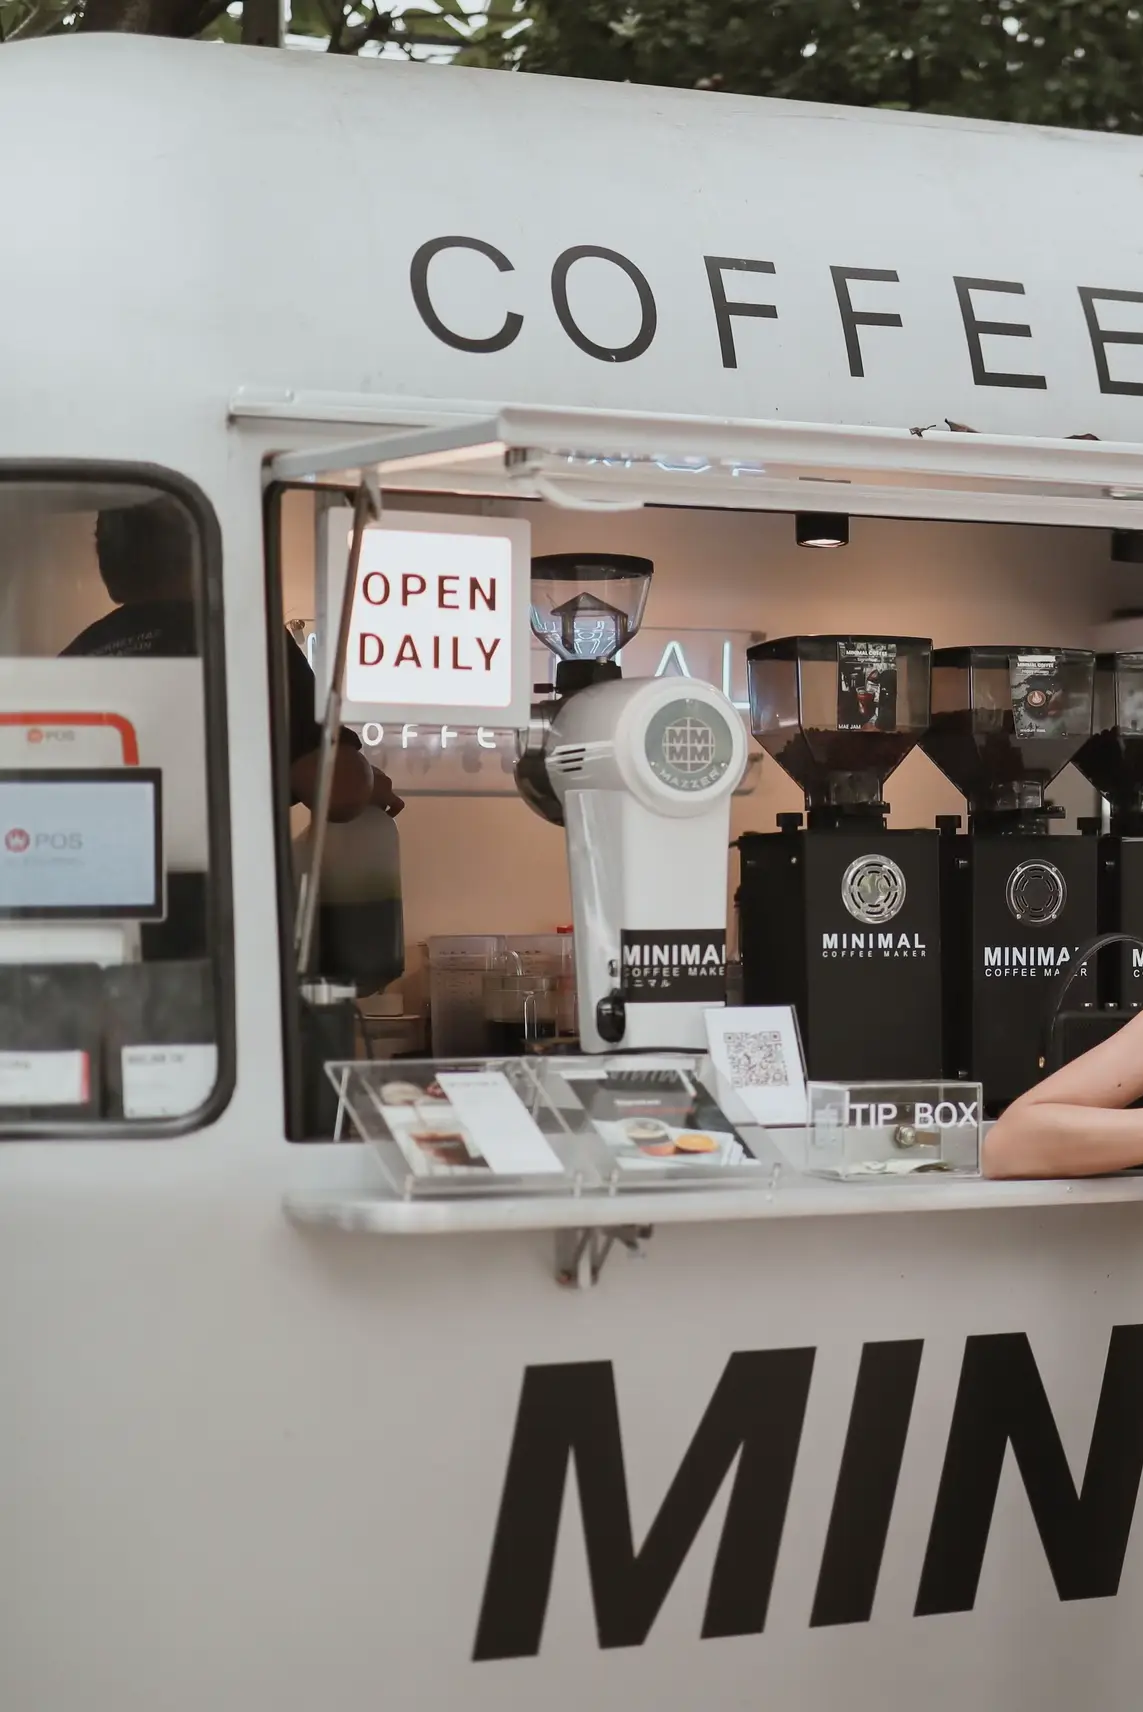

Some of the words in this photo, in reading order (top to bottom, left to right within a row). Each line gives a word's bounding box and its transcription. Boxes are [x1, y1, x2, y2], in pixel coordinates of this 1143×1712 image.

[362, 571, 497, 611] OPEN
[358, 632, 501, 671] DAILY
[362, 722, 497, 749] OFFE
[659, 767, 720, 790] MAZZER
[35, 833, 84, 850] POS
[822, 933, 926, 949] MINIMAL
[822, 950, 873, 958] COFFEE
[984, 946, 1088, 966] MINIMA
[688, 966, 726, 976] MAKE
[985, 968, 1037, 977] COFFEE
[1044, 968, 1088, 977] MAR
[850, 1103, 898, 1129] TIP
[914, 1101, 978, 1129] BOX
